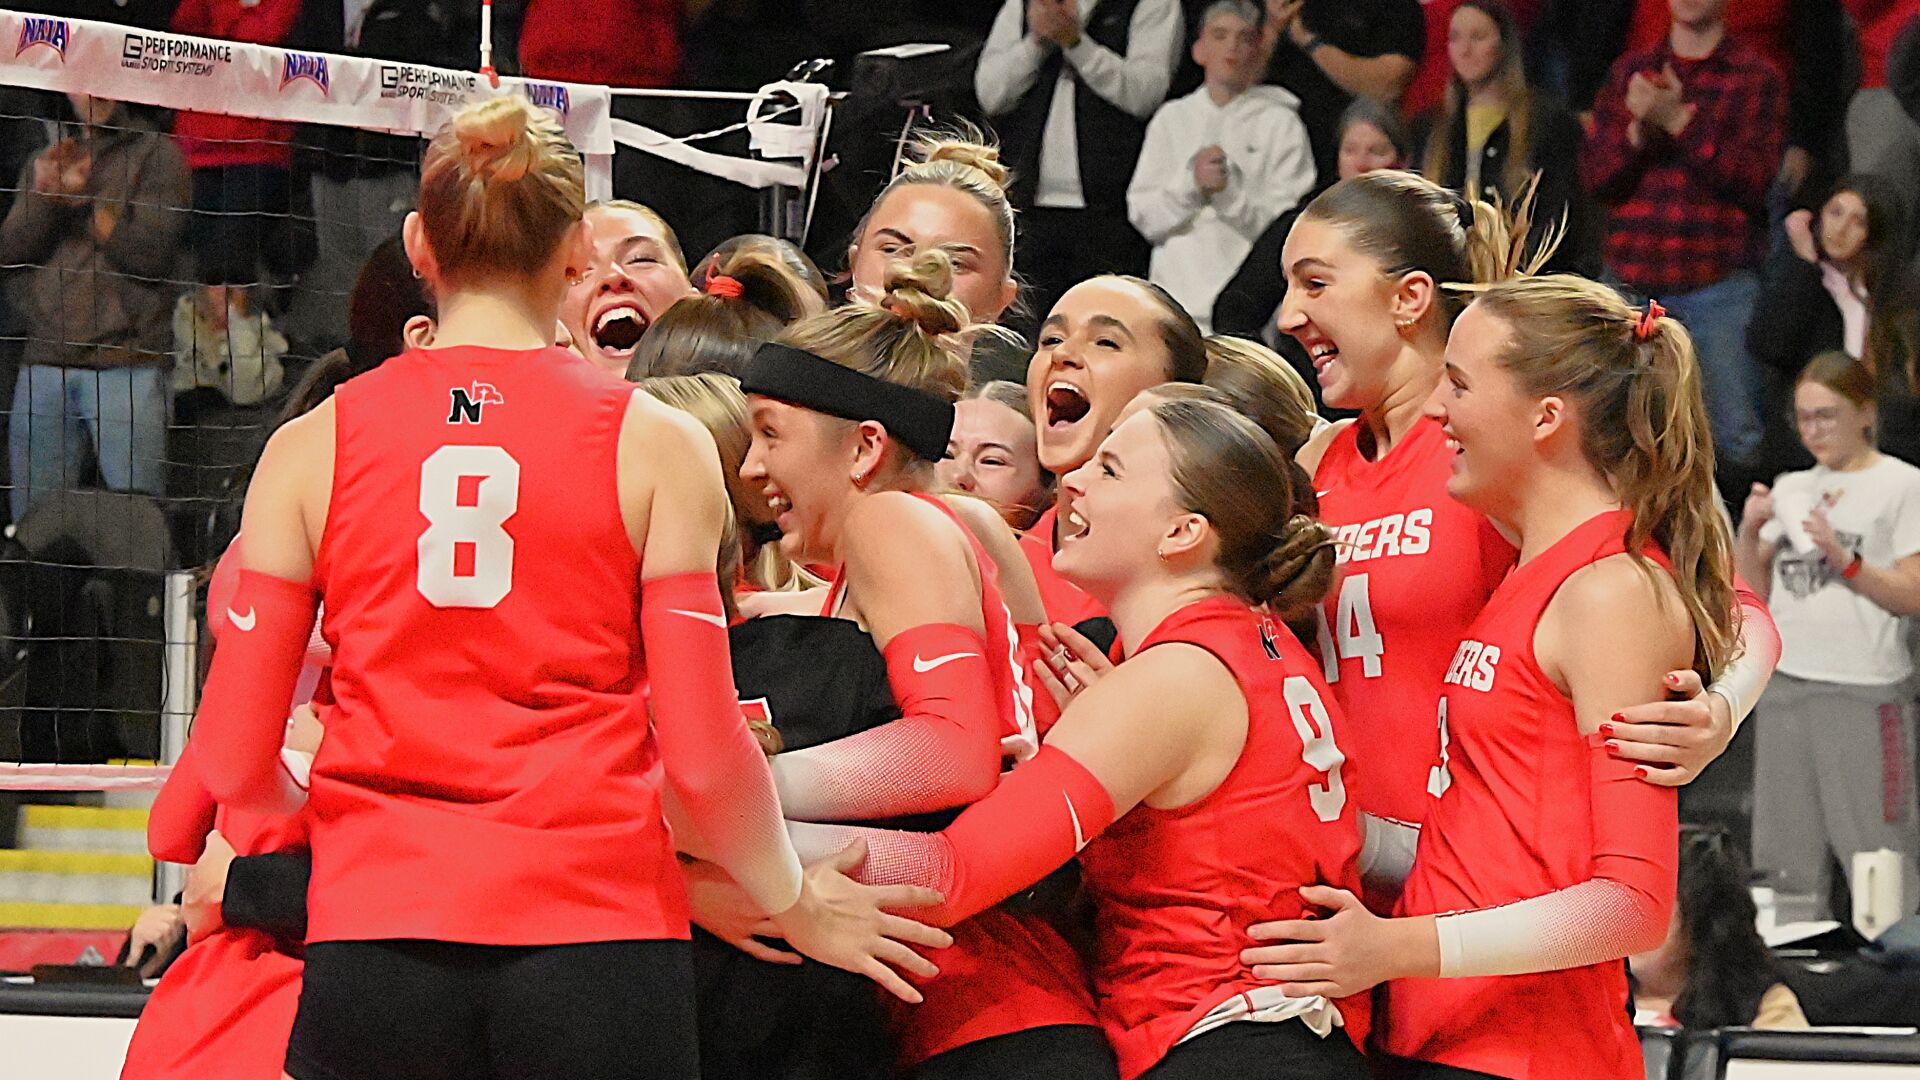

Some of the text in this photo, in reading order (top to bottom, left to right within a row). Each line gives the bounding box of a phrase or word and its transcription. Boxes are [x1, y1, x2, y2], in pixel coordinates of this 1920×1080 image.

[20, 17, 67, 55] NAIA
[145, 37, 232, 63] PERFORMANCE
[283, 53, 329, 89] NAIA
[448, 387, 483, 424] N
[416, 444, 520, 608] 8
[1283, 675, 1346, 823] 9
